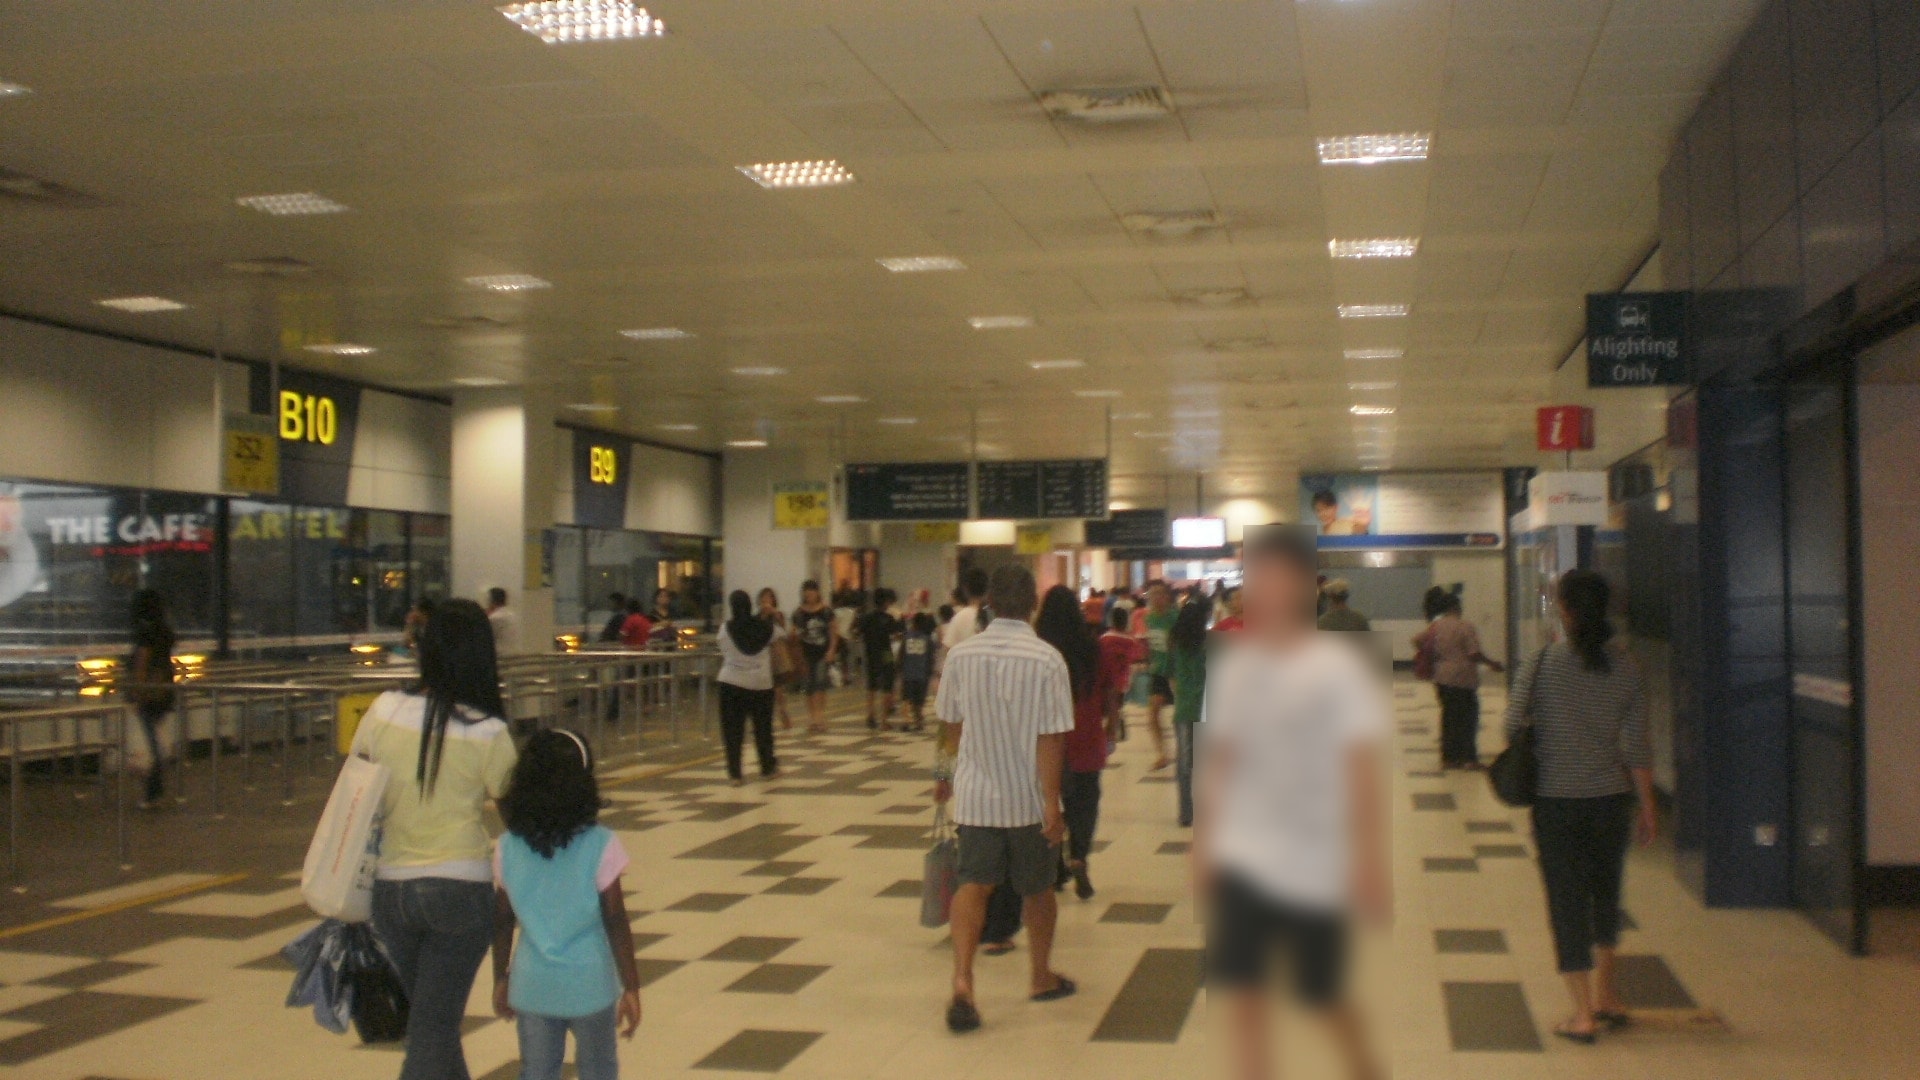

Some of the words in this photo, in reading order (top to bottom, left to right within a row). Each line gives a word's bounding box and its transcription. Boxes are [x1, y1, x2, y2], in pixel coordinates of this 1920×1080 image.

[1592, 337, 1679, 359] Alighting
[1613, 363, 1658, 382] Only
[280, 389, 336, 445] B10
[590, 446, 616, 485] B9
[46, 517, 111, 544] THE
